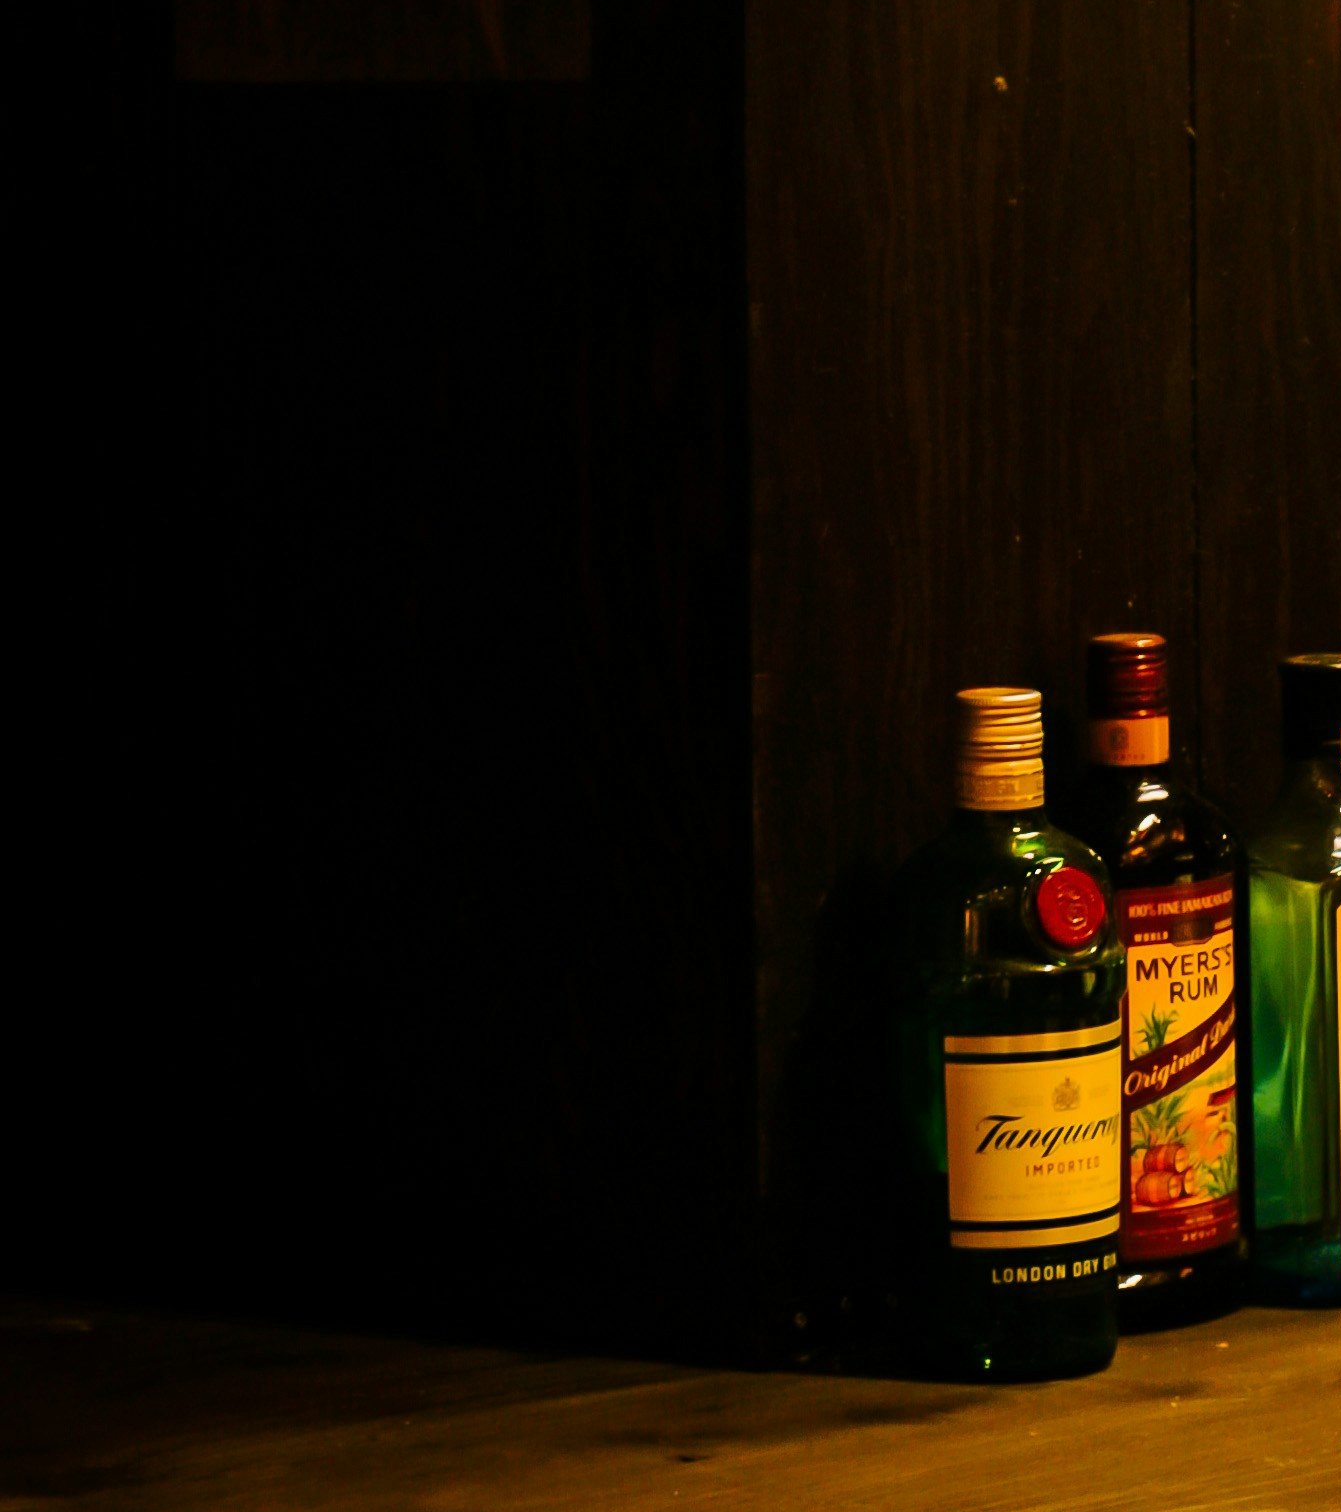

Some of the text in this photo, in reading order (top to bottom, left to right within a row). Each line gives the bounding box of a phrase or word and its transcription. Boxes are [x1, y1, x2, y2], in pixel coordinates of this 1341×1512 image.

[1169, 974, 1219, 1004] RUM
[1124, 1032, 1210, 1097] Original
[1025, 1154, 1102, 1178] IMPORTED
[991, 1262, 1067, 1286] LONDON
[1071, 1254, 1101, 1279] DRY
